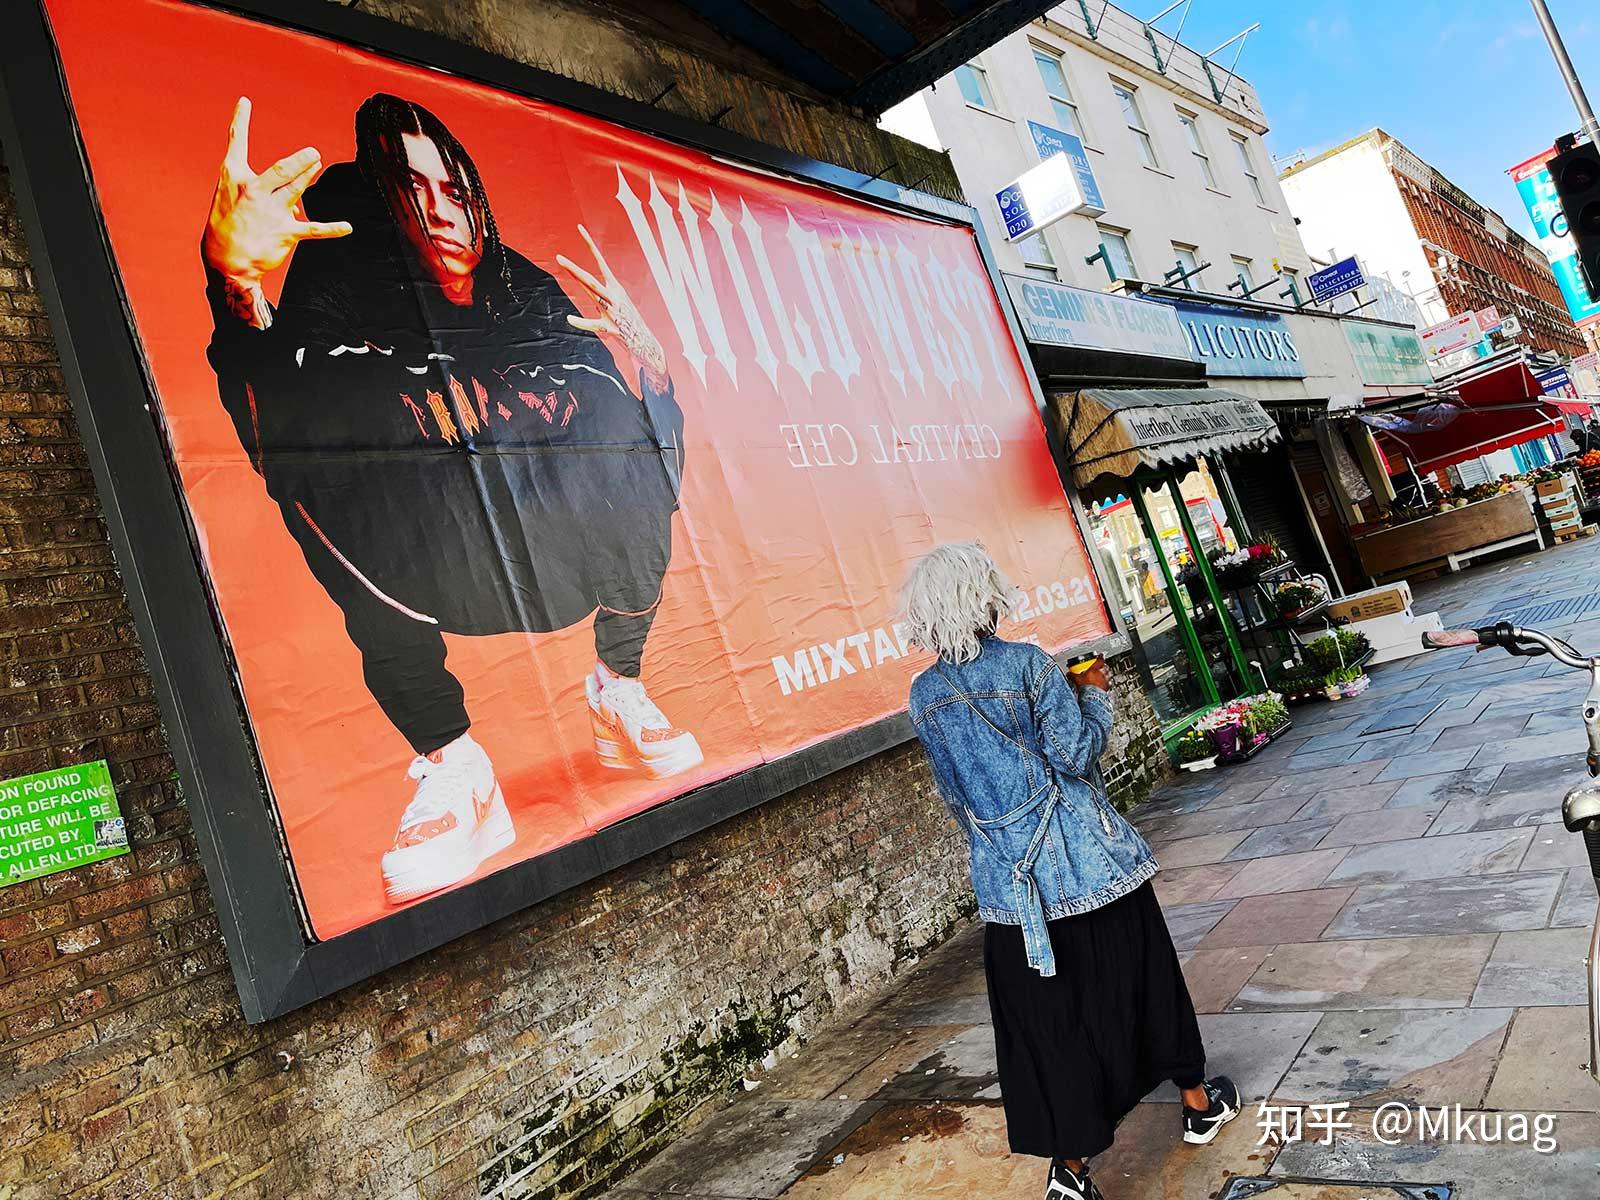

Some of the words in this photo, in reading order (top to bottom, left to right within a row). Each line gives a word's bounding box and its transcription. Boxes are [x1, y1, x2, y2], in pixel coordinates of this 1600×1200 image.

[615, 162, 862, 395] WILD
[834, 221, 1014, 403] WEST
[1314, 269, 1360, 292] SOLICITORS
[1025, 317, 1073, 342] Interflora
[1112, 300, 1173, 336] FLORIST
[1128, 417, 1176, 440] Interflora
[771, 622, 911, 696] MIXTAP
[23, 773, 81, 796] FOUND
[27, 784, 111, 814] DEFACING
[46, 809, 86, 828] WILL
[89, 802, 112, 818] BE
[58, 828, 79, 844] BY
[9, 852, 61, 877] ALLEN
